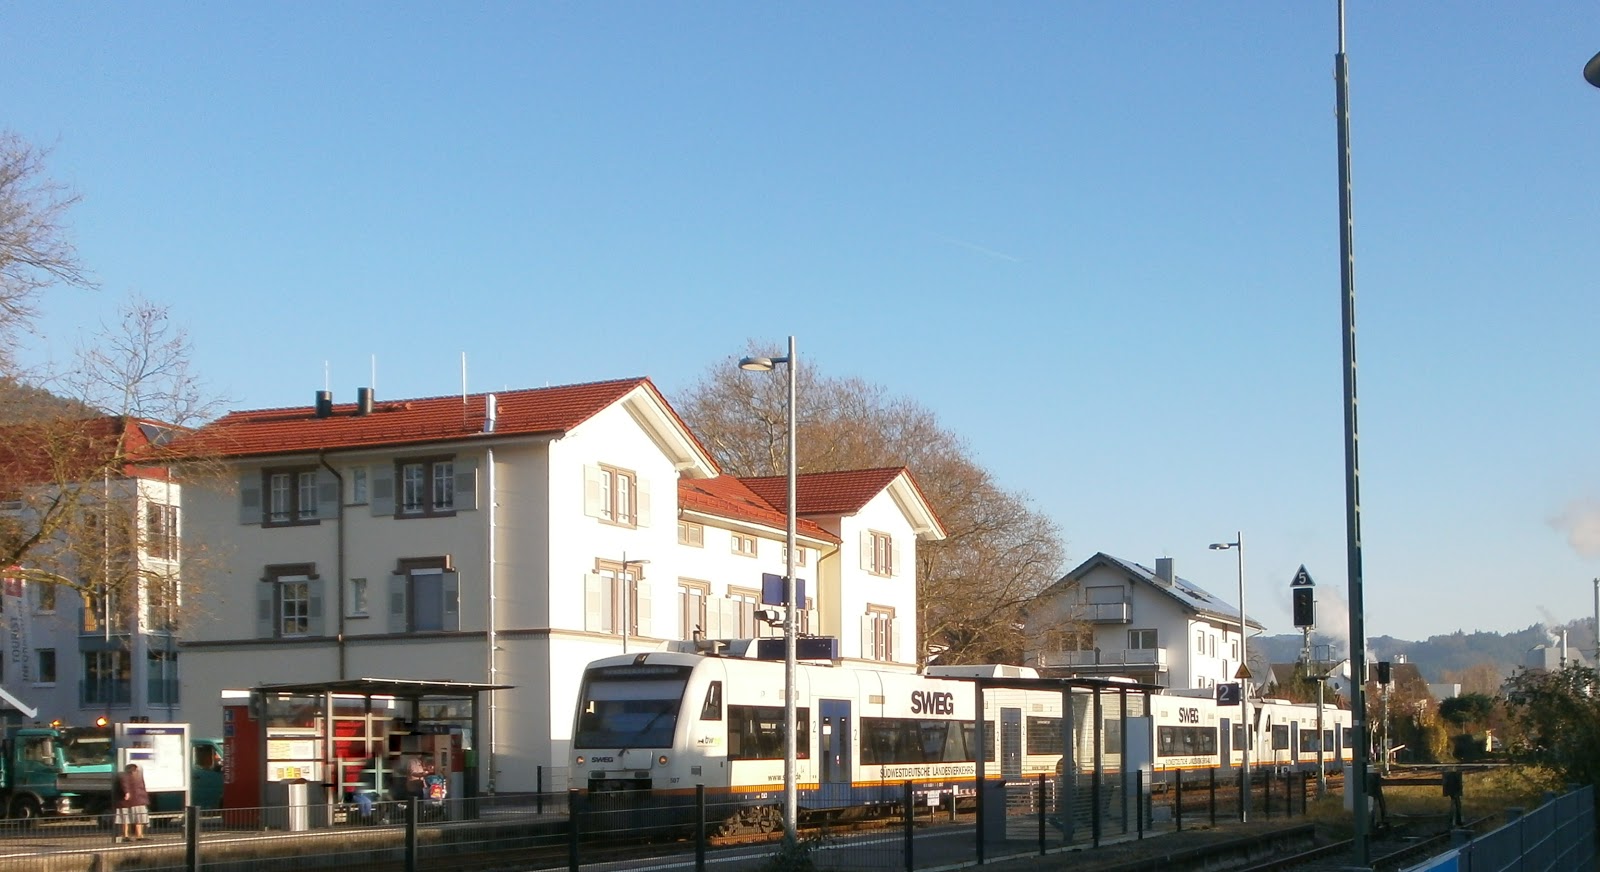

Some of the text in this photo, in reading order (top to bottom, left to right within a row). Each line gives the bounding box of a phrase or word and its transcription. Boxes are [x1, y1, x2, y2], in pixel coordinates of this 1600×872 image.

[1299, 572, 1306, 585] 5
[10, 616, 20, 663] TOURIST
[1219, 684, 1230, 701] 2
[911, 690, 954, 715] SWEG
[1178, 707, 1200, 724] SWEG
[812, 720, 817, 733] 2
[853, 728, 858, 741] 2
[880, 766, 931, 778] SÜDWESTDEUTSCHE
